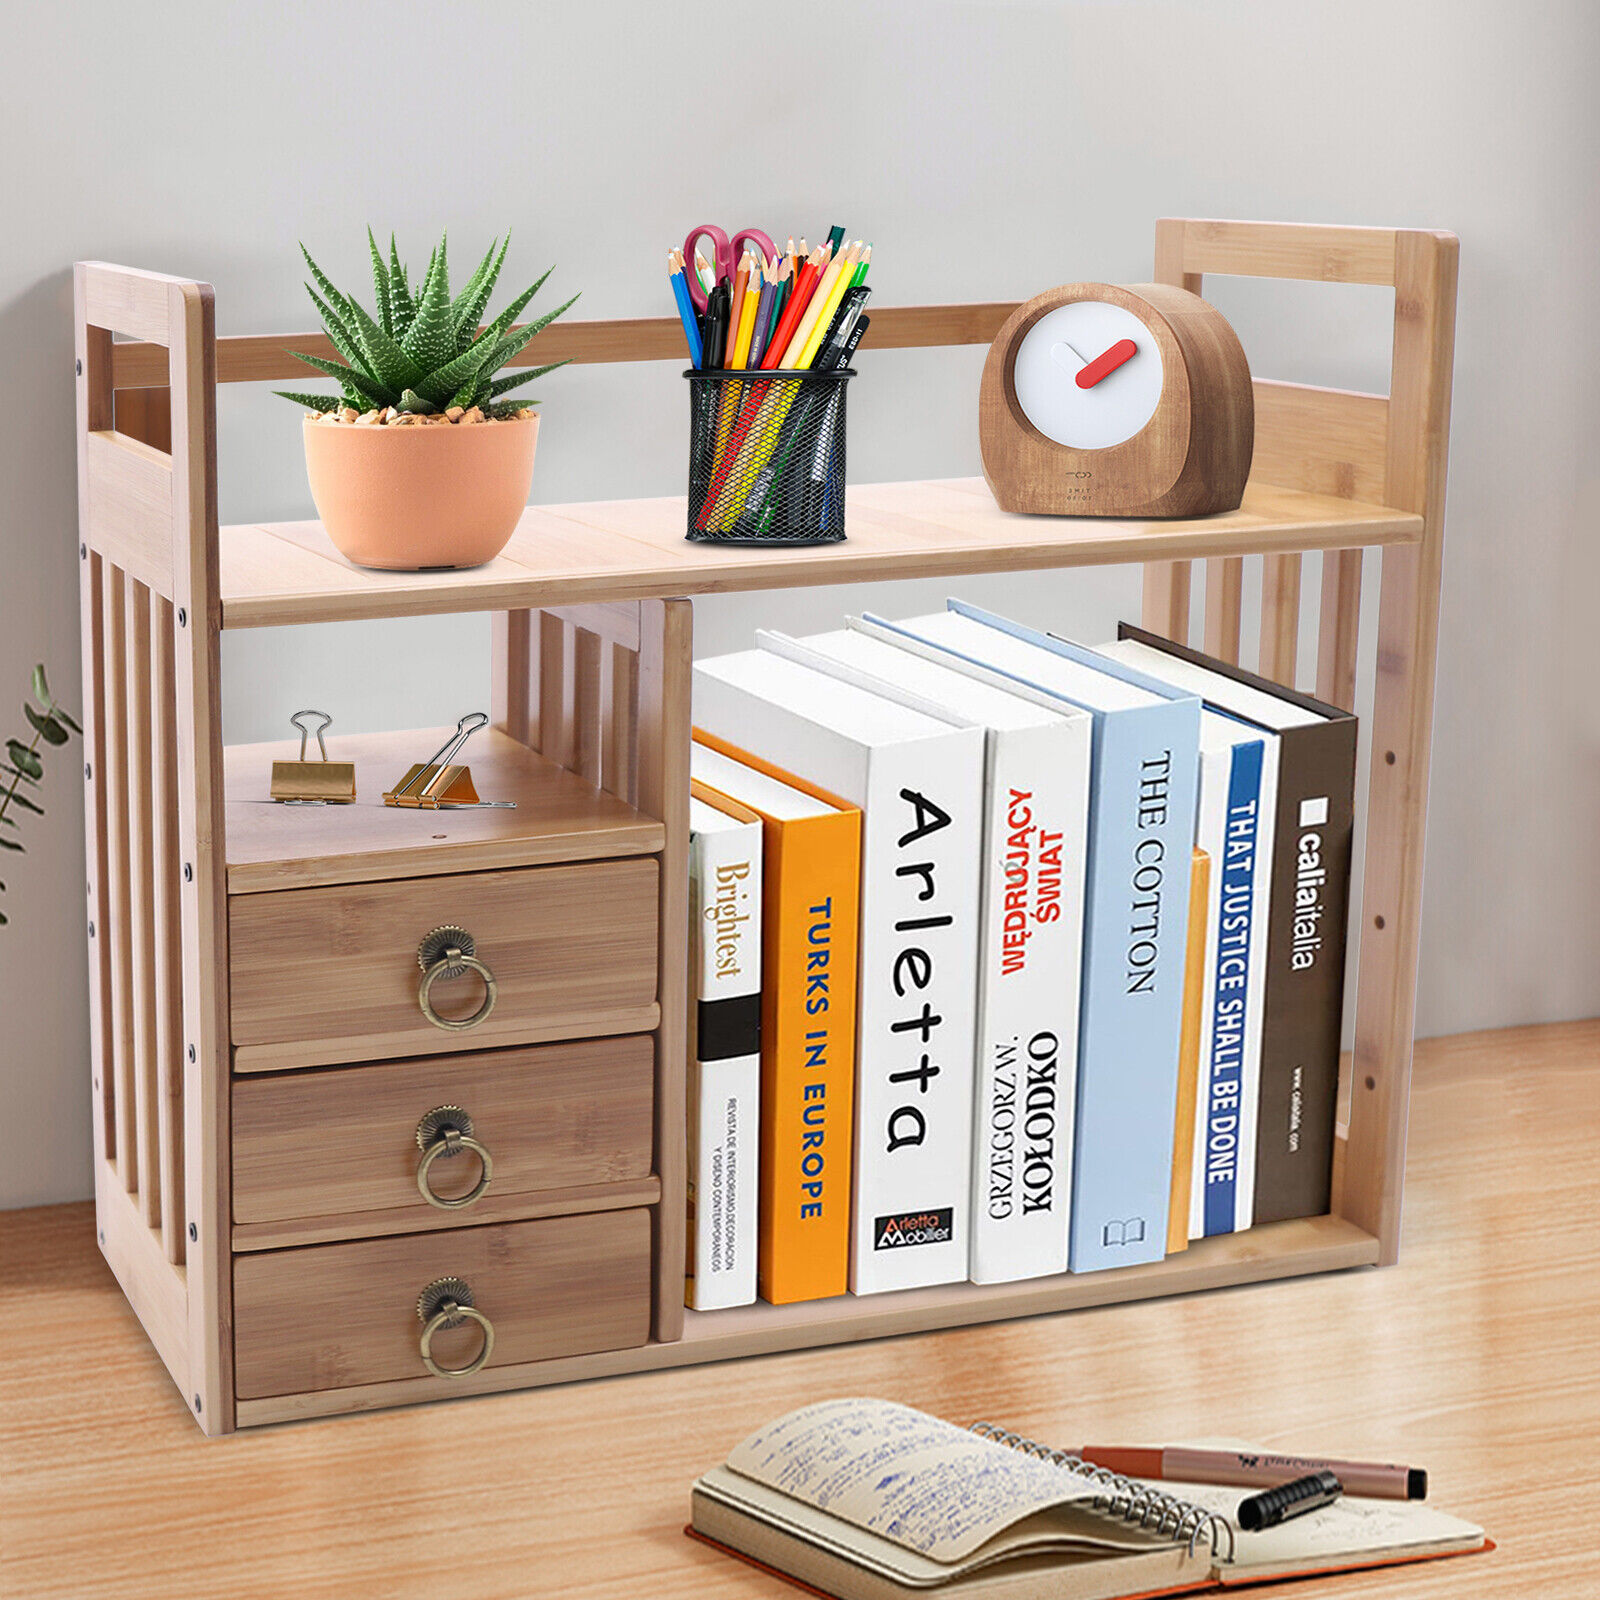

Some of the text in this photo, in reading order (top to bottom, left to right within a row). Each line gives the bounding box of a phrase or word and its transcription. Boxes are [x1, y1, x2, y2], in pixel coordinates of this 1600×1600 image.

[704, 861, 750, 980] Brightest
[1002, 788, 1037, 976] WĘDRUJĄCY
[1030, 829, 1063, 924] ŚWIAT
[1126, 750, 1171, 994] THE COTTON
[1292, 832, 1326, 971] caliaitalia
[887, 788, 952, 1153] Arletta
[1208, 801, 1256, 1183] THAT JUSTICE SHALL BE DONE
[727, 1098, 737, 1135] REVISTA
[801, 897, 832, 1219] TURKS IN EUROPE
[1022, 1031, 1059, 1216] KOŁODKO
[727, 1136, 736, 1148] DE
[987, 1076, 1016, 1221] GRZEGORZ
